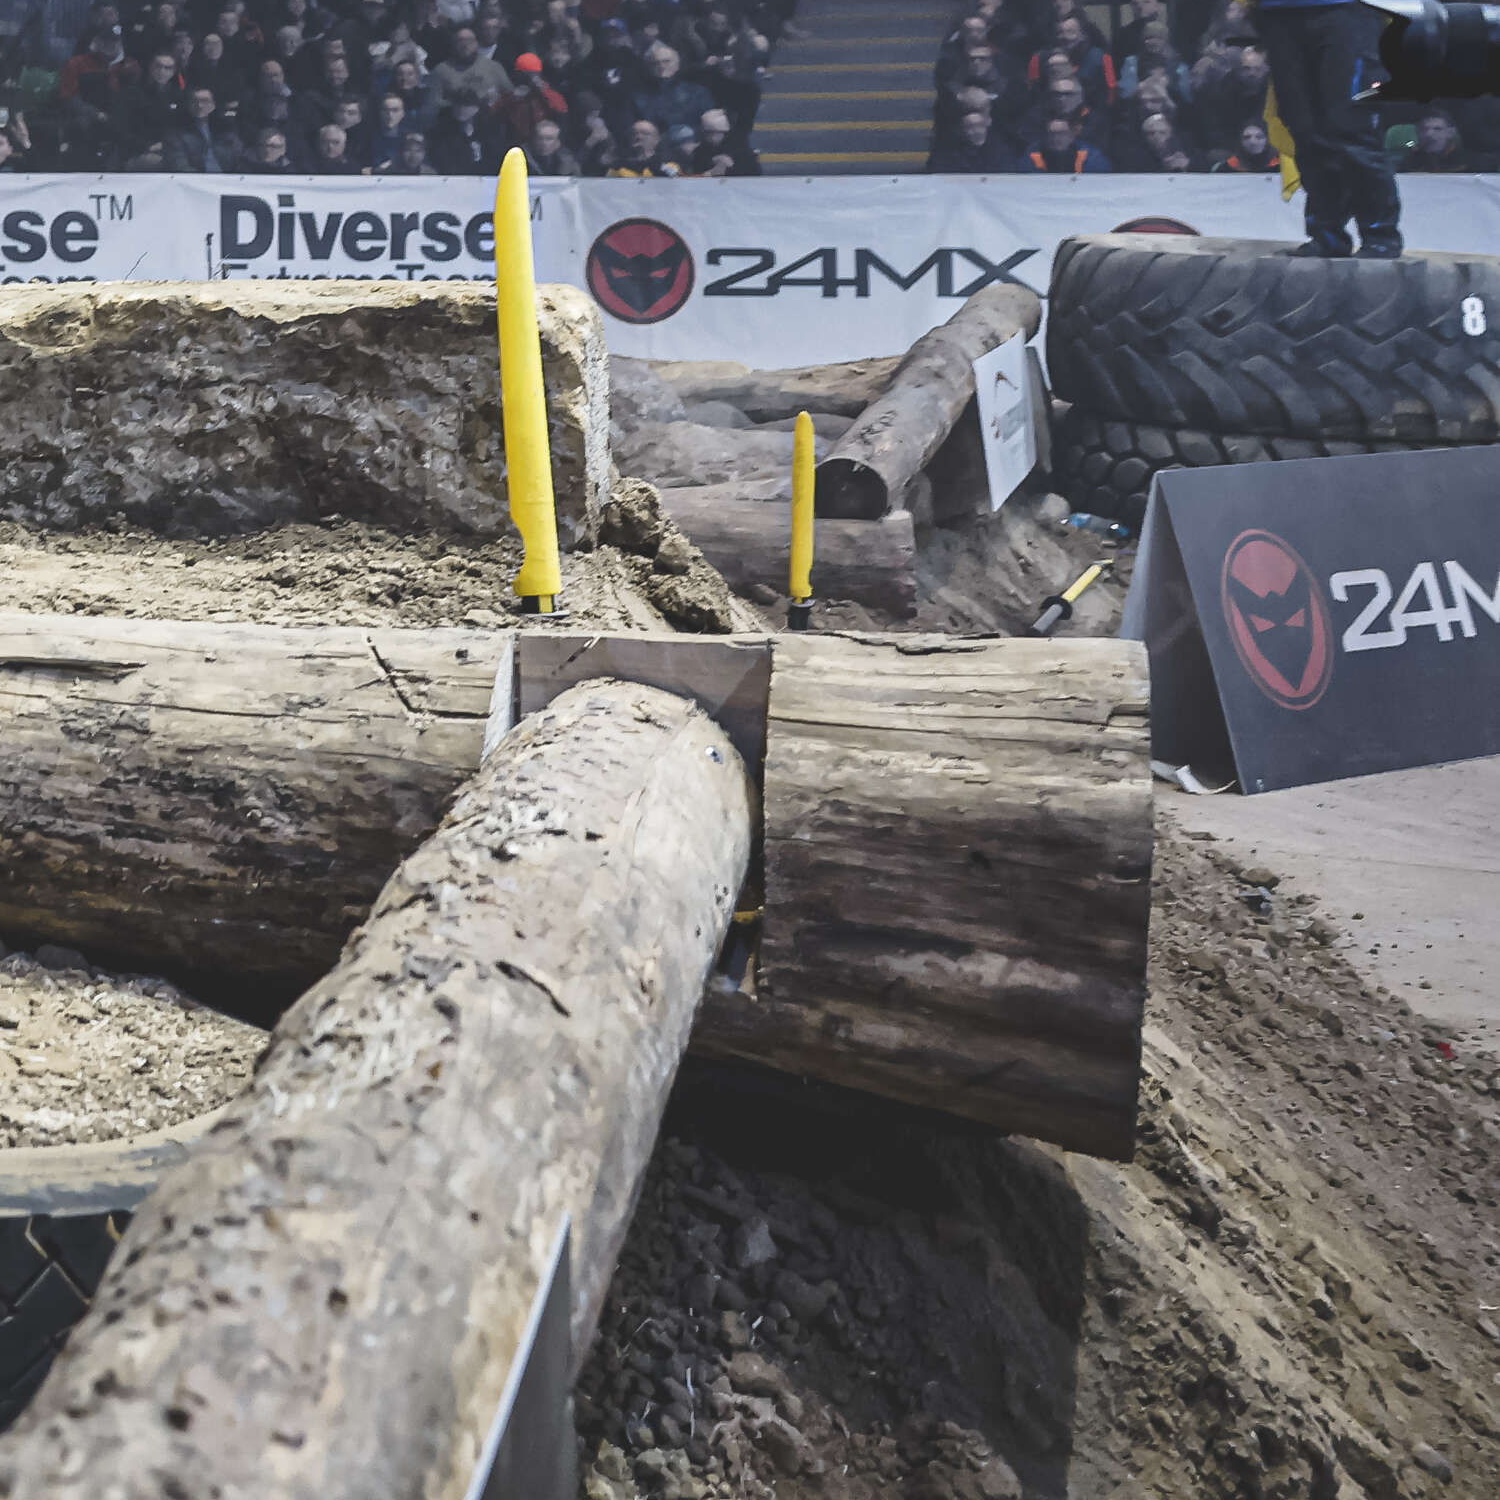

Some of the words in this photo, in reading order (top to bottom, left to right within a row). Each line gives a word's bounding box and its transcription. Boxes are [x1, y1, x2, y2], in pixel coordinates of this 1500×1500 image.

[89, 194, 133, 221] TM
[220, 194, 497, 262] Diverse
[703, 247, 1047, 299] 24MX
[1462, 296, 1487, 336] 8
[1329, 560, 1500, 653] 24M
